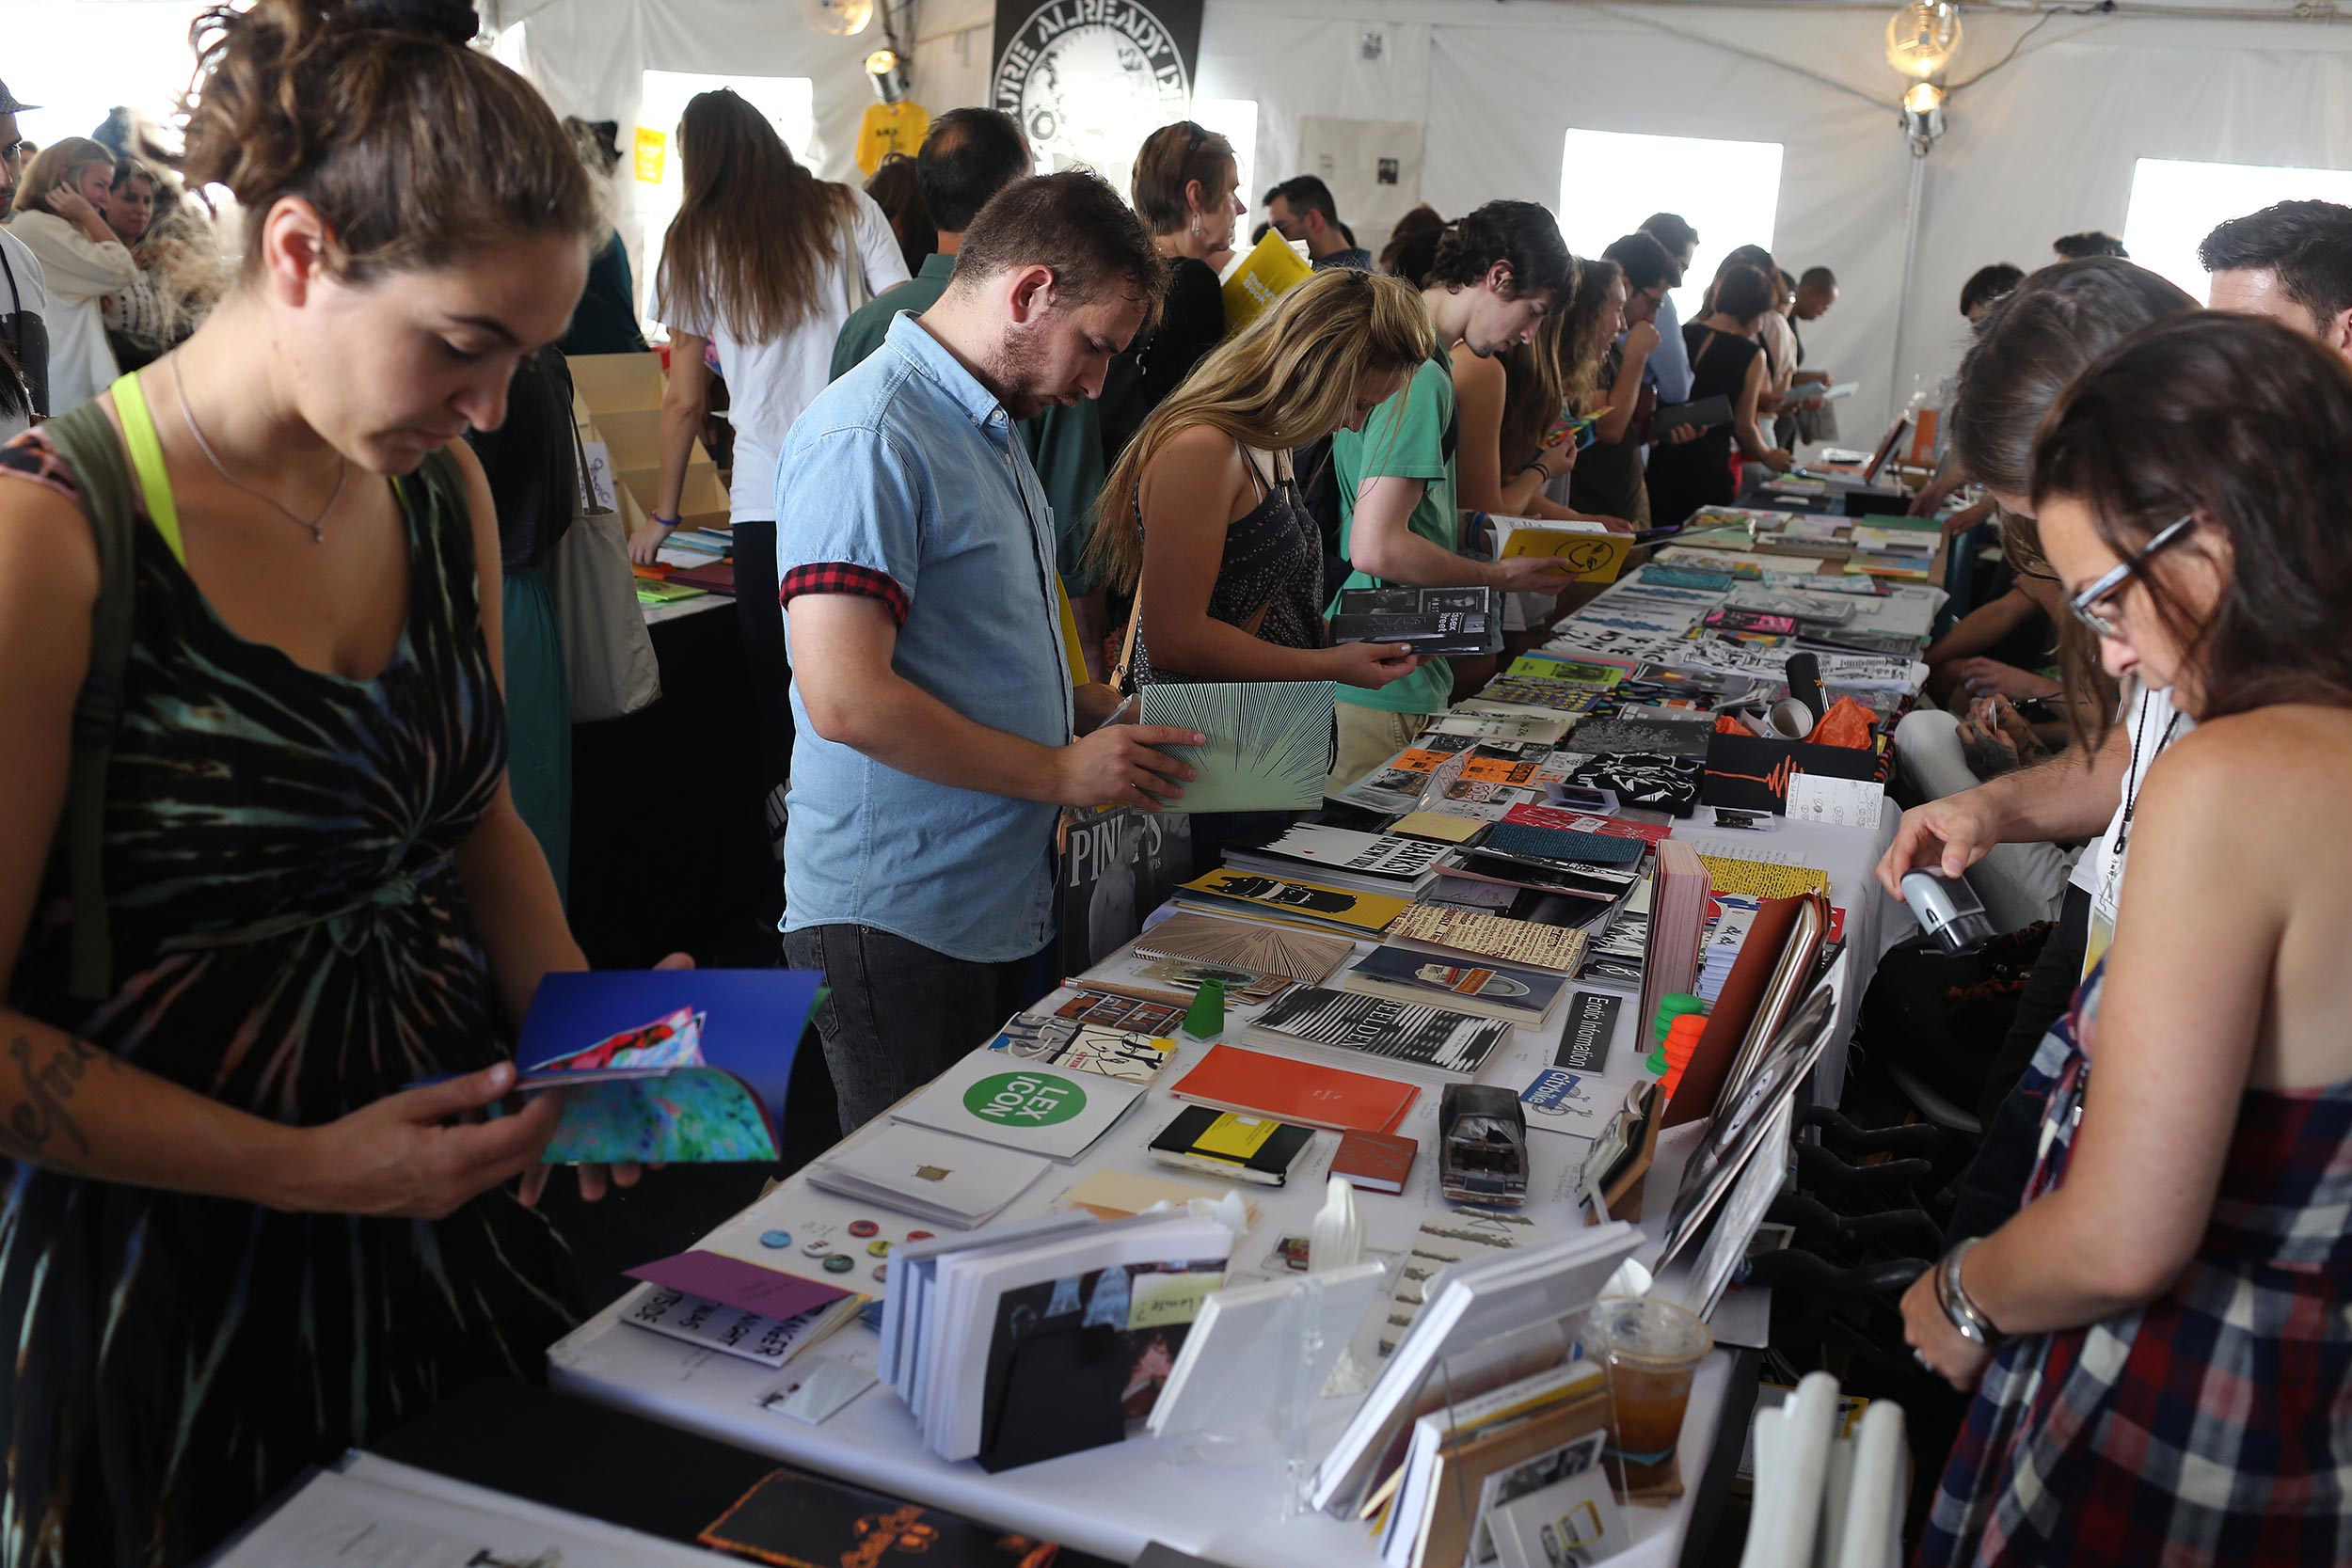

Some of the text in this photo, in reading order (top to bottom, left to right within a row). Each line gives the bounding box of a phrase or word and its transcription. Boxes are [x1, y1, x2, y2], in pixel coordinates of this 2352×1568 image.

[1243, 279, 1265, 305] Book
[1568, 996, 1609, 1068] Erotic Information
[979, 1075, 1042, 1117] ICON
[1014, 1085, 1069, 1120] LEX
